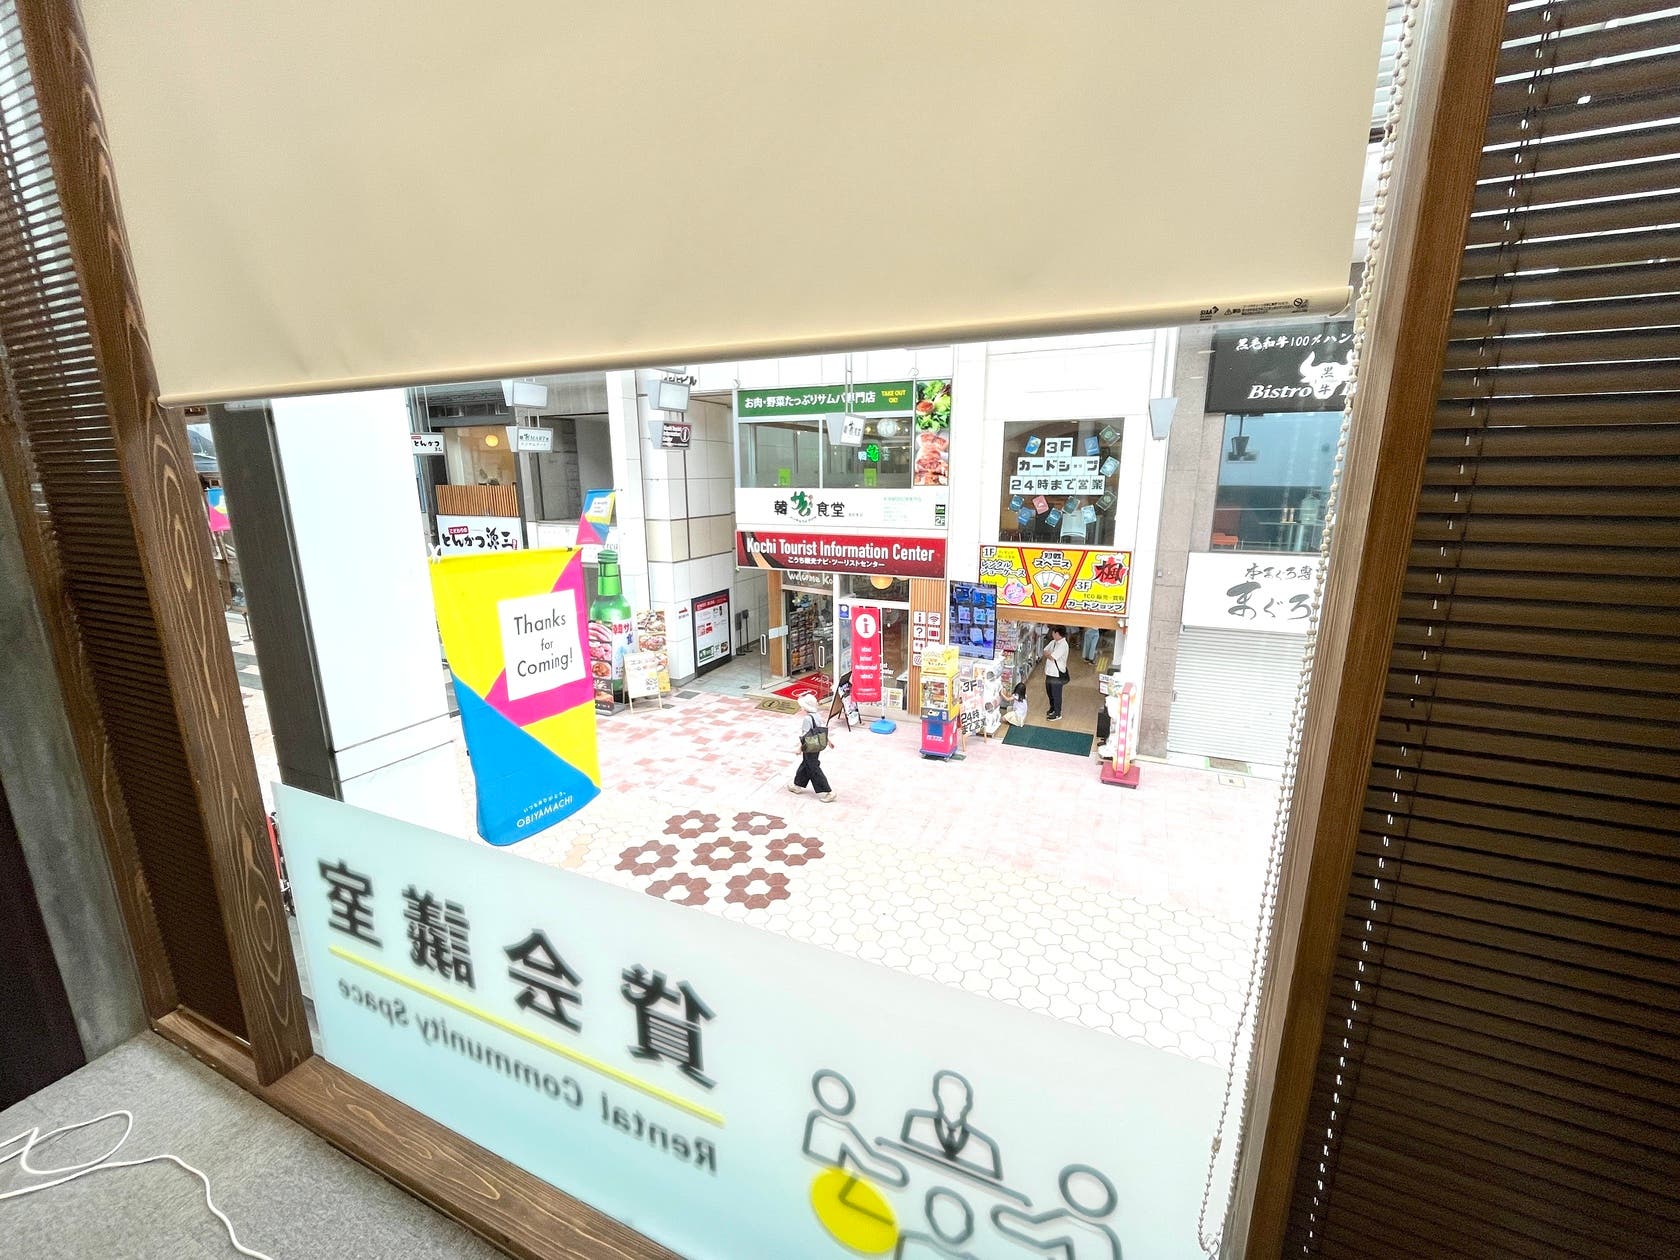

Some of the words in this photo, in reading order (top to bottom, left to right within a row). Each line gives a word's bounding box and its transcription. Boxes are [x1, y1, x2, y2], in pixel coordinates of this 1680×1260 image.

[1248, 385, 1312, 399] Bistro
[1046, 440, 1072, 454] 3F
[1011, 479, 1104, 491] 24時まで営業
[746, 537, 777, 554] Kochi
[779, 539, 818, 556] Tourist
[819, 541, 889, 560] Information
[892, 544, 935, 562] Center
[984, 548, 995, 556] 1F
[982, 560, 1012, 569] レンタル
[1076, 580, 1091, 590] 3F
[1042, 594, 1056, 603] 2F
[1226, 581, 1312, 620] まぐろ
[514, 608, 566, 635] Thanks
[541, 638, 553, 651] for
[517, 647, 573, 677] Coming!
[962, 679, 978, 693] 3F
[516, 795, 573, 828] OBIYAMACHI
